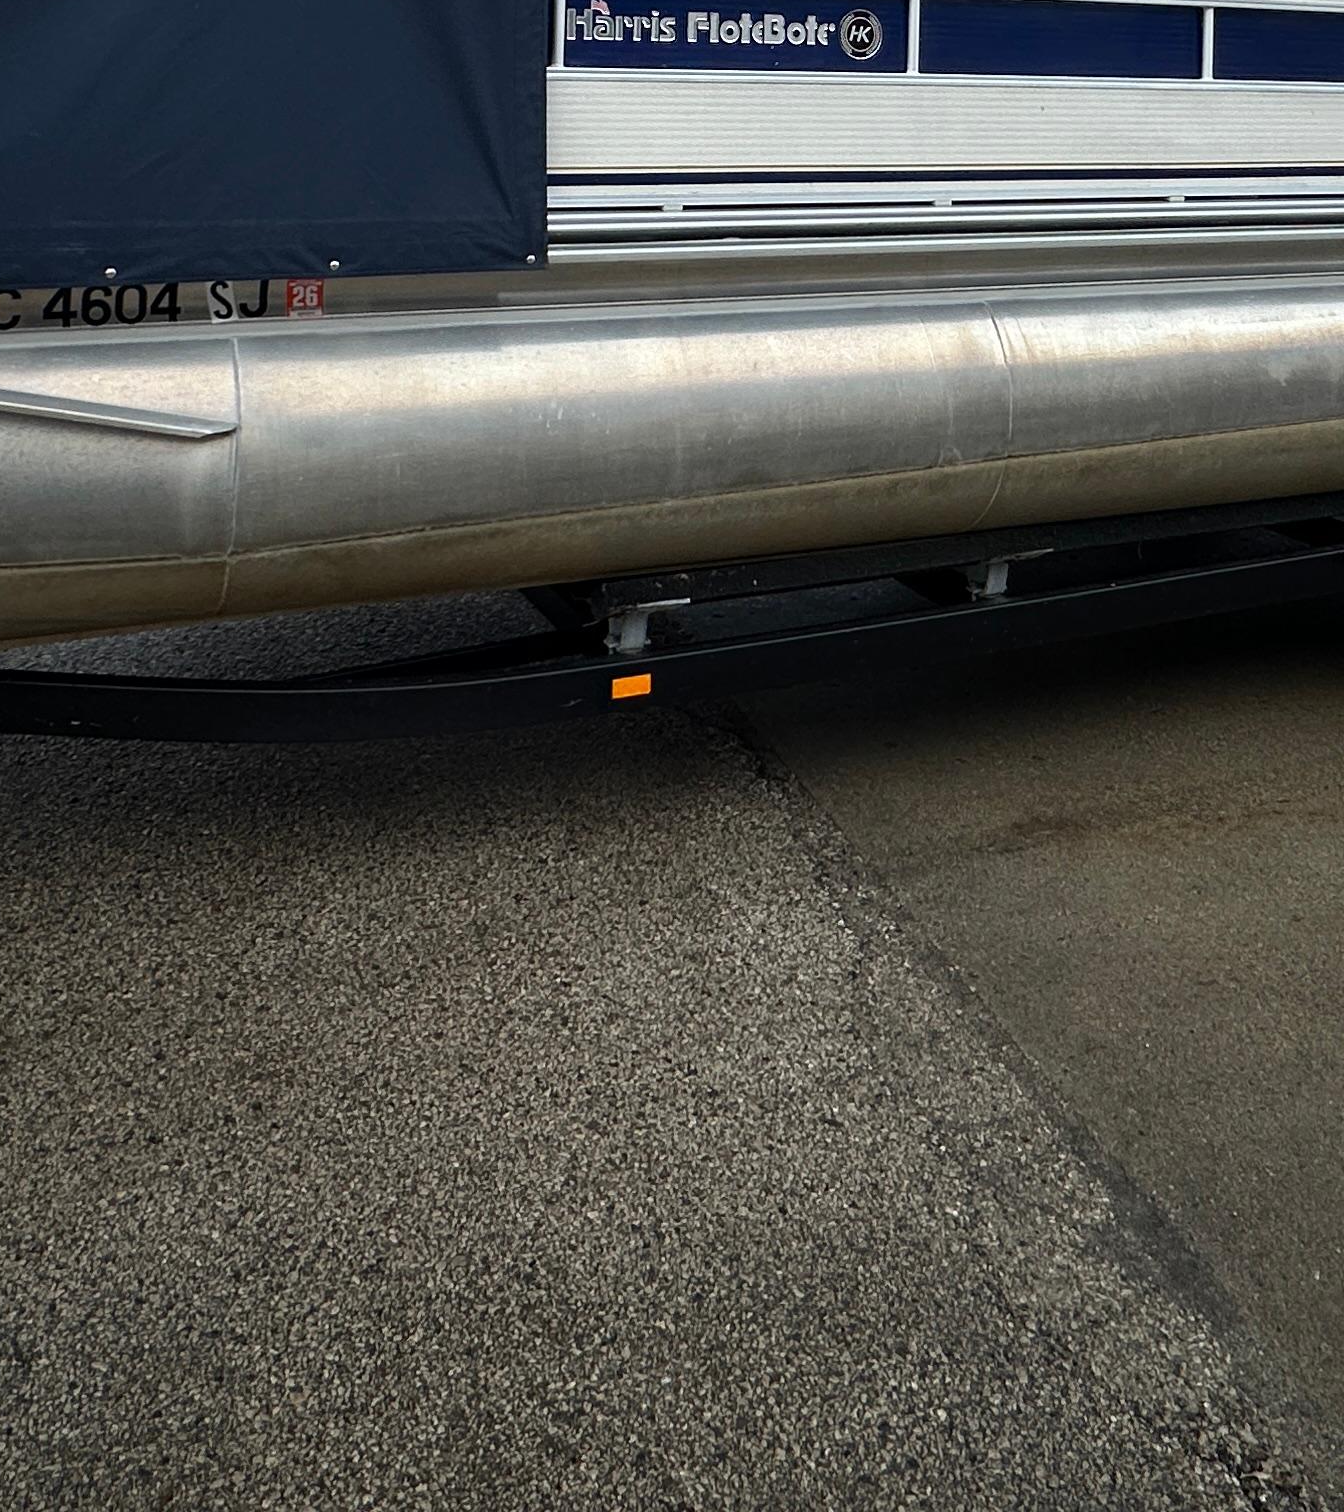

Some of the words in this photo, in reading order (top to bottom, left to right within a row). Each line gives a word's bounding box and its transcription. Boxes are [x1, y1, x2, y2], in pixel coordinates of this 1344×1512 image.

[566, 8, 676, 42] Harris
[686, 10, 830, 46] FloteBote
[848, 24, 872, 43] HK
[42, 283, 182, 328] 4604
[210, 279, 270, 320] SJ
[292, 285, 318, 307] 26
